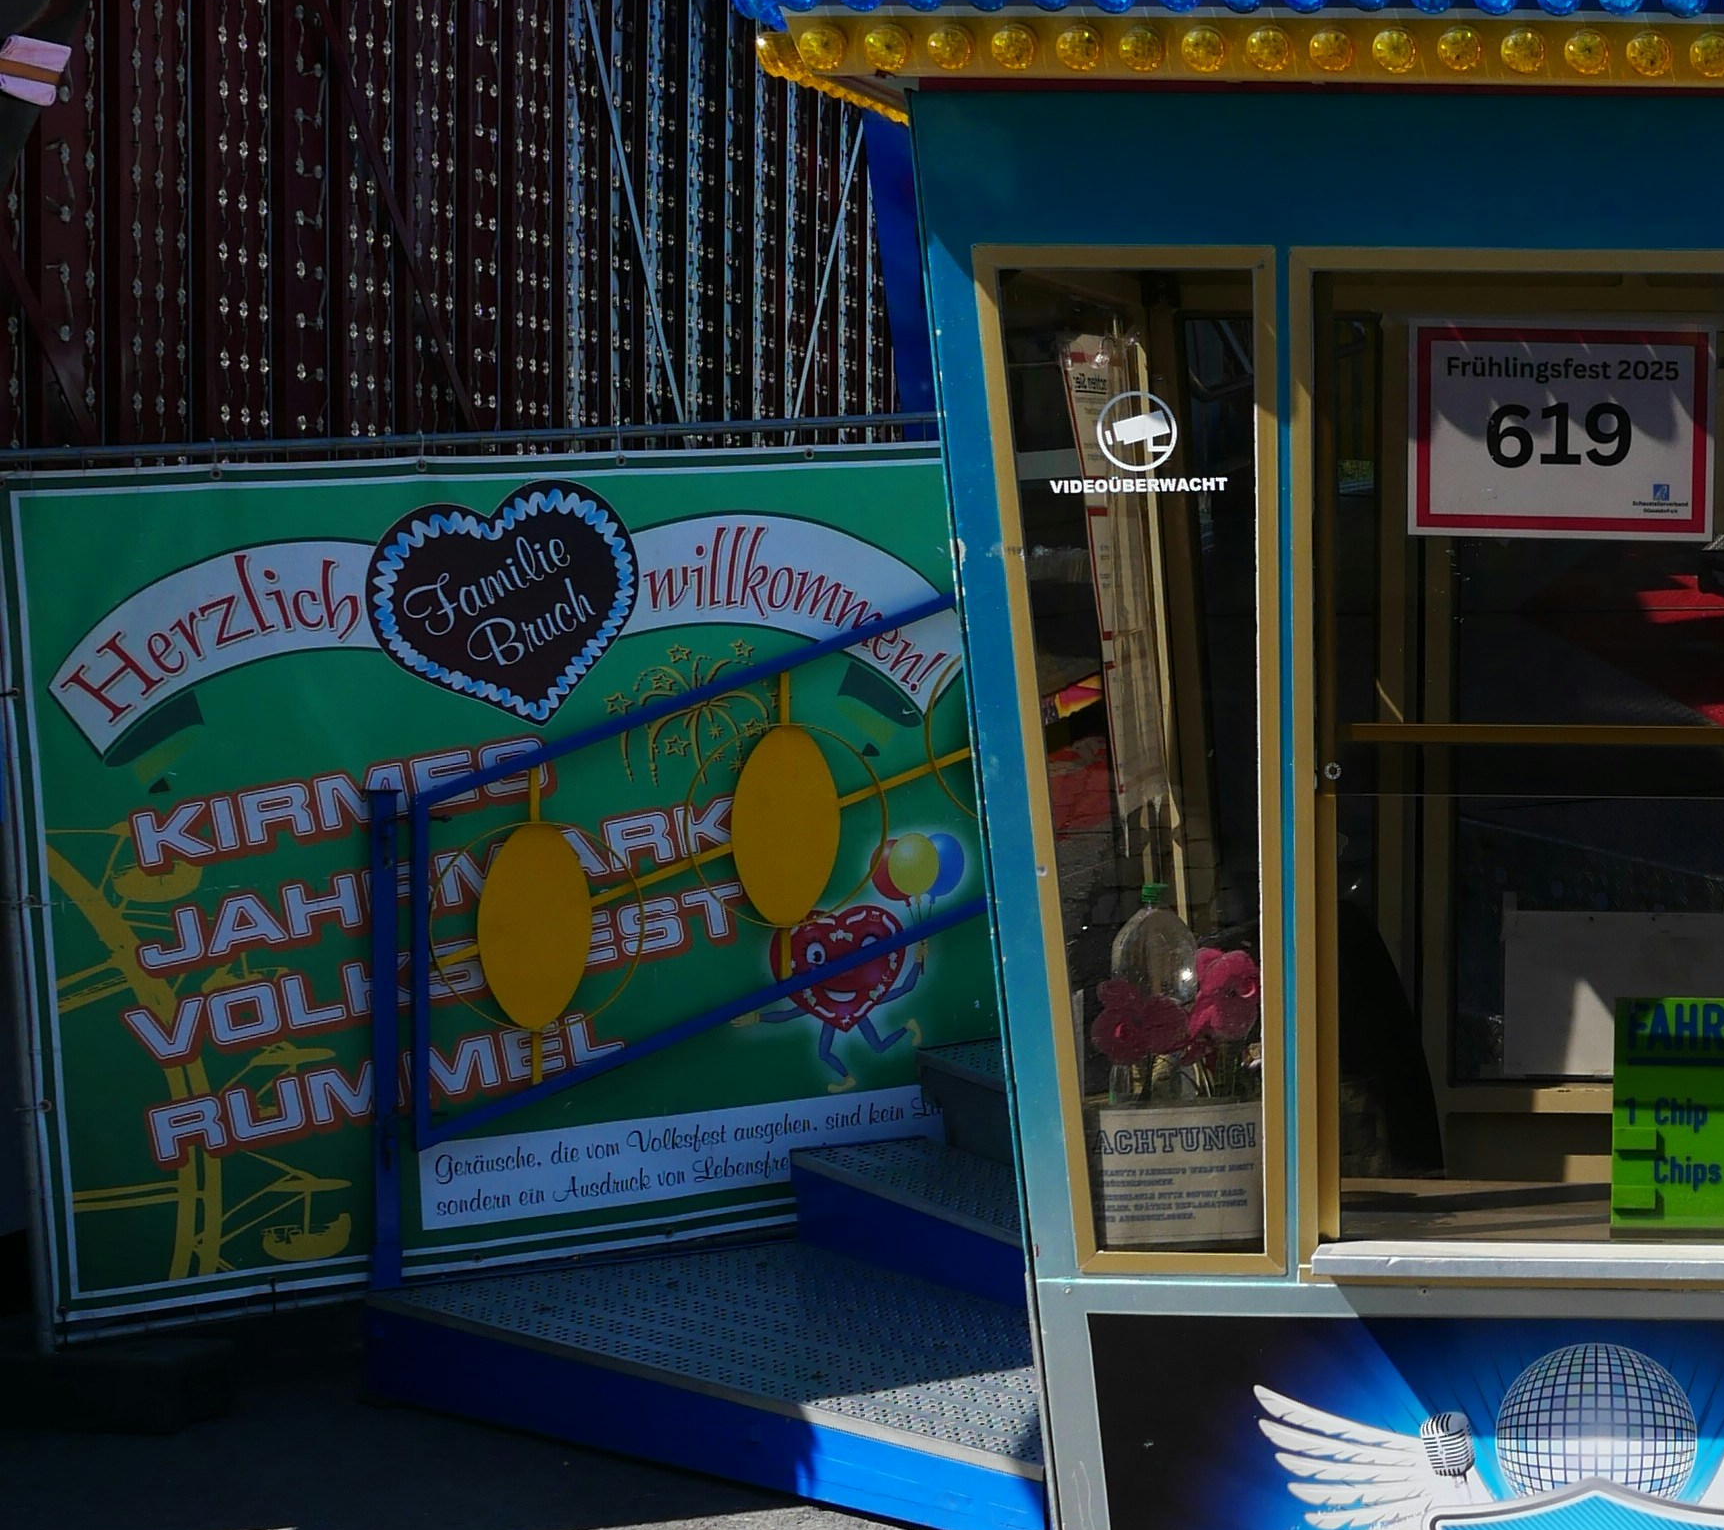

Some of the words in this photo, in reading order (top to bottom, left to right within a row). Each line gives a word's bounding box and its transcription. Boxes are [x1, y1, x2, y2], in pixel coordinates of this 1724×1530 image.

[1445, 355, 1612, 384] Frühlingsfest
[1617, 359, 1680, 382] 2025
[1486, 401, 1632, 469] 619
[1049, 476, 1229, 494] VIDEOÜBERWACHT
[403, 530, 572, 639] Familie
[641, 525, 950, 694] willkommen!
[61, 552, 362, 728] Herzlich
[466, 588, 600, 672] Bruch
[132, 736, 550, 869] KIRMES
[148, 1012, 630, 1163] RUMMEL
[1624, 1096, 1638, 1126] 1
[1654, 1096, 1709, 1134] Chip
[550, 1139, 581, 1166] die
[586, 1140, 621, 1160] vom
[624, 1123, 728, 1154] Volksfest
[824, 1109, 862, 1131] sind
[868, 1101, 905, 1125] kein
[1094, 1122, 1256, 1155] ACHTUNG!
[435, 1190, 512, 1218] sondern
[518, 1185, 546, 1207] ein
[551, 1167, 652, 1204] Ausdruck
[657, 1167, 688, 1187] von
[691, 1151, 791, 1184] Lebensfre
[1653, 1155, 1723, 1193] Chips
